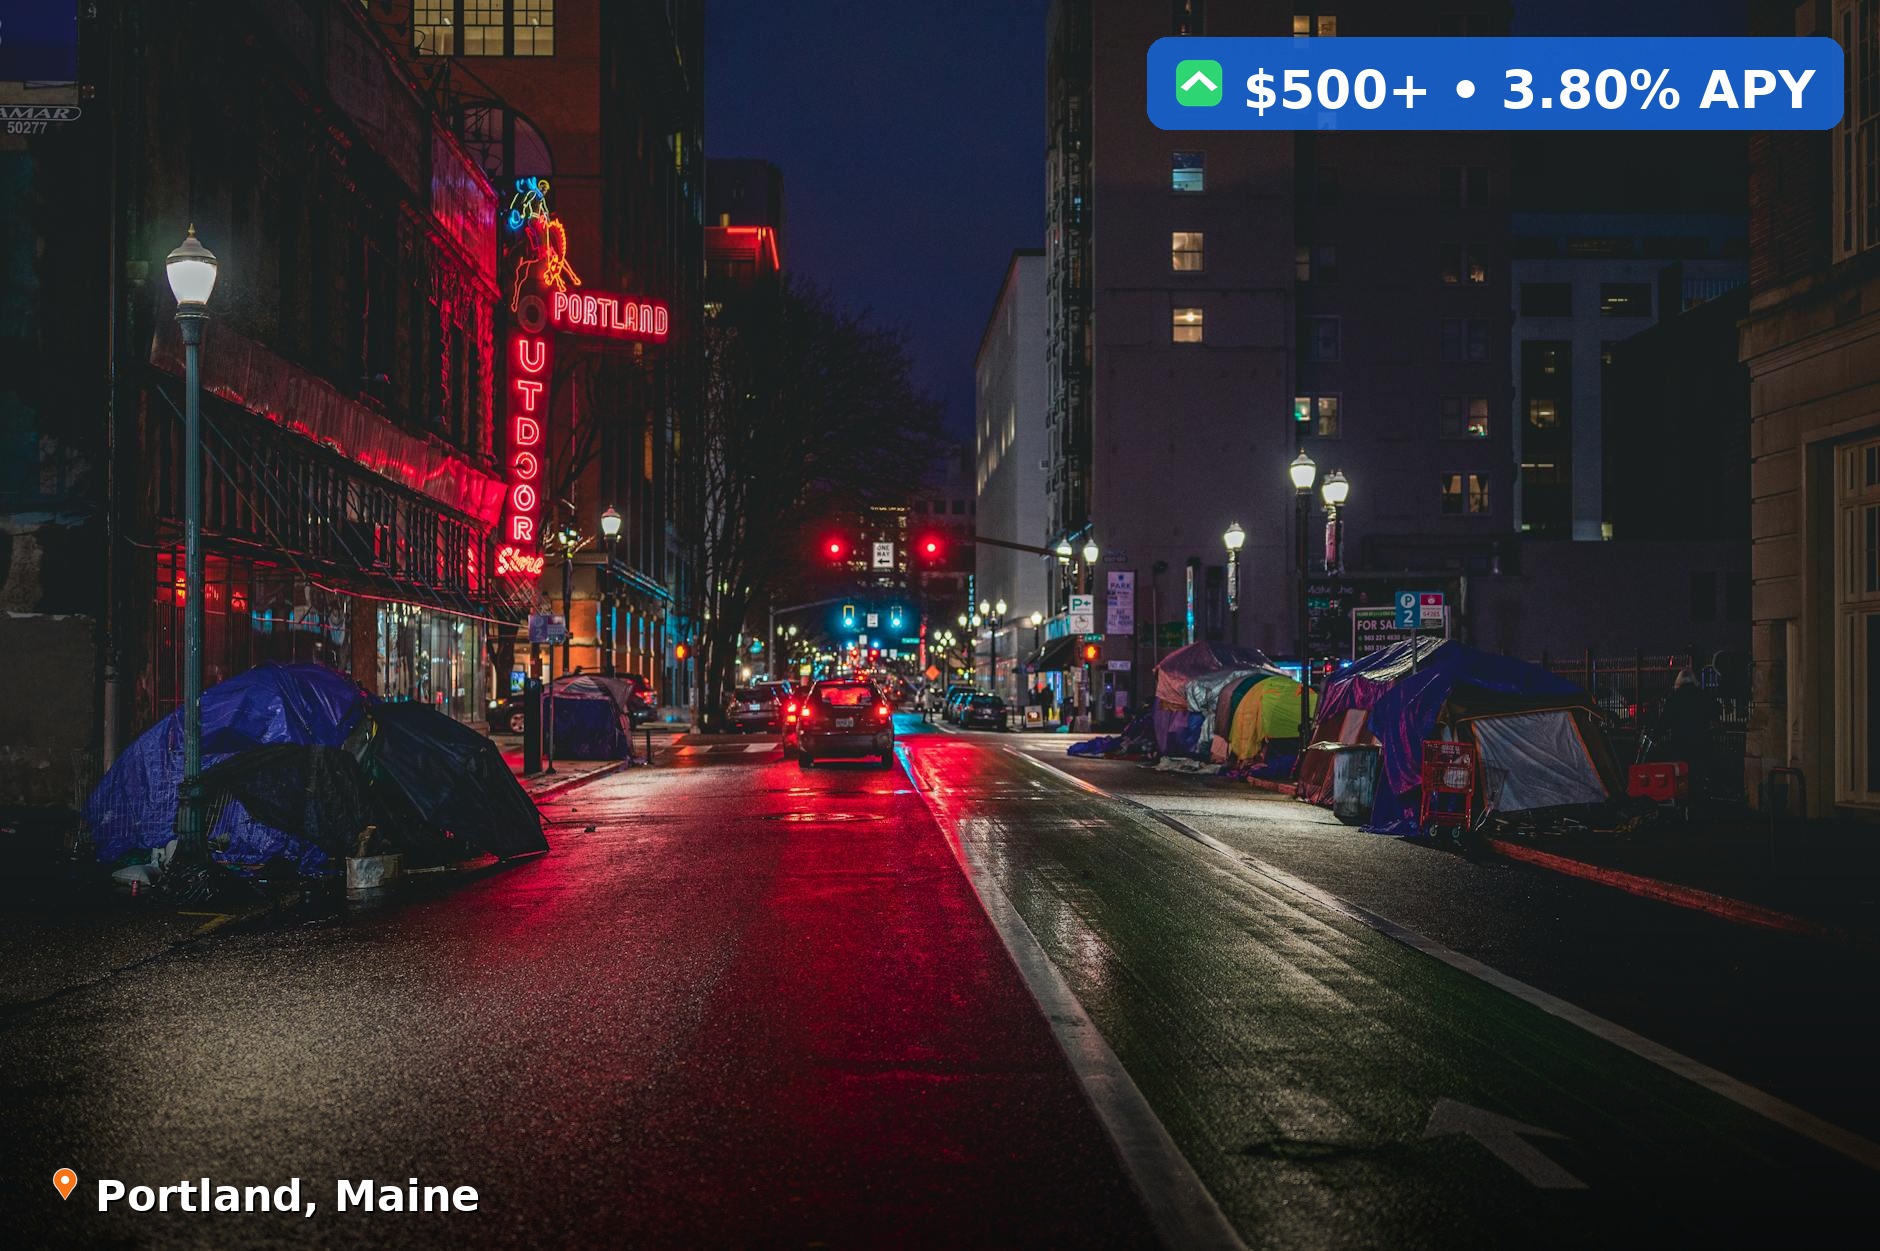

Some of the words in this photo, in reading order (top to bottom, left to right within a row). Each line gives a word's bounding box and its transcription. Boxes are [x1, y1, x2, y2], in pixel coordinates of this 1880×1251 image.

[7, 121, 47, 134] 50277
[554, 291, 669, 335] PORTLAND
[513, 295, 548, 541] OUTDOOR
[498, 547, 545, 575] Store
[1110, 582, 1131, 590] PARK
[1072, 598, 1083, 611] P
[1405, 596, 1412, 606] P
[1403, 610, 1413, 623] 2
[1357, 620, 1377, 630] FOR
[1380, 620, 1397, 630] SAL
